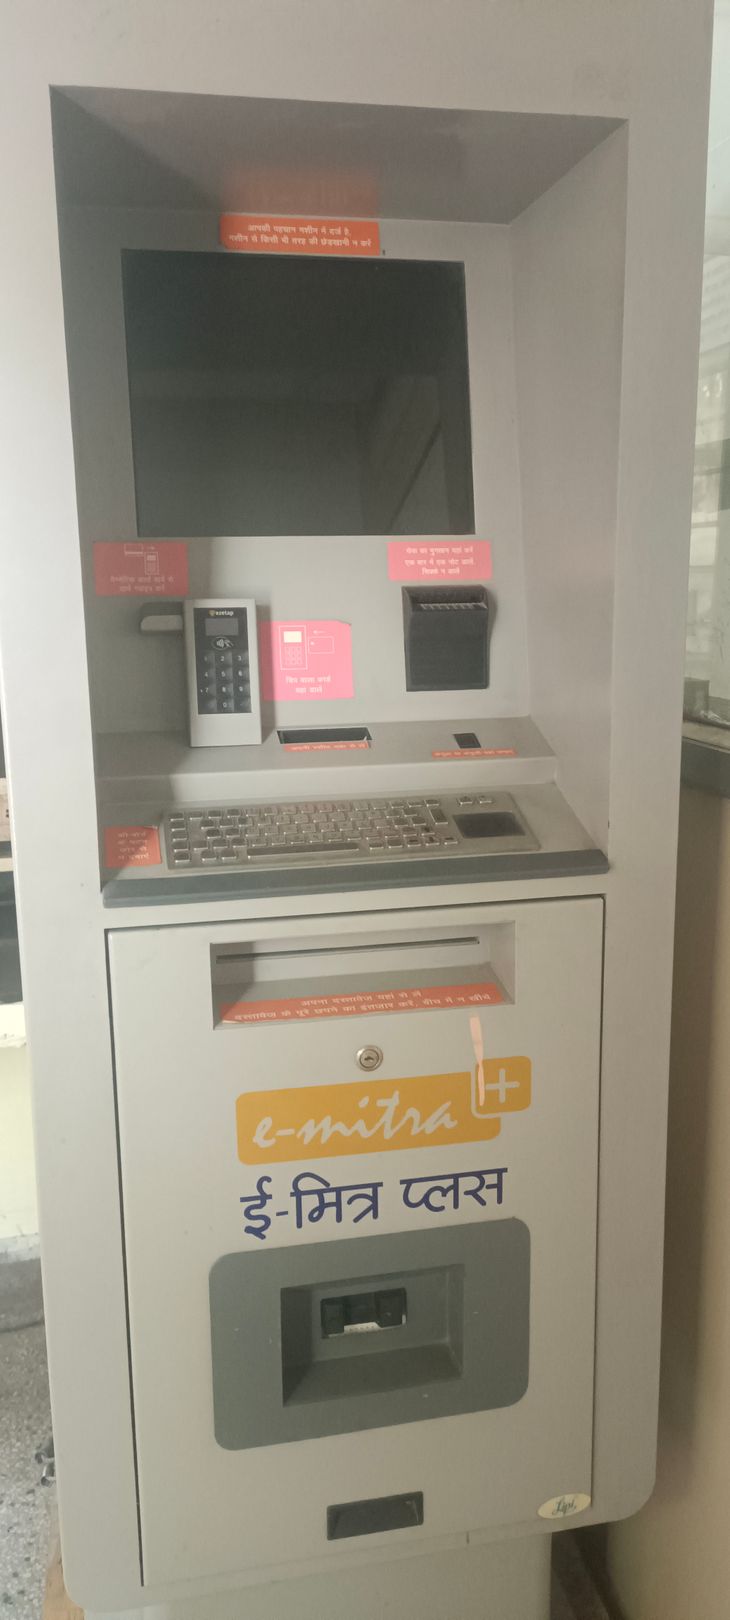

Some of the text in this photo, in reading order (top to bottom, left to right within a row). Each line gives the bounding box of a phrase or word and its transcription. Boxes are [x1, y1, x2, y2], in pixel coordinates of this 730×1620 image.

[248, 224, 270, 232] आपकी
[273, 225, 296, 233] पहचान
[299, 225, 318, 234] मशीन
[229, 233, 248, 242] मशीन
[260, 234, 278, 244] किसी
[292, 237, 306, 245] तरह
[301, 998, 328, 1006] अपना
[253, 1090, 458, 1148] e-mitra
[240, 1168, 508, 1240] ई-मित्र प्लस
